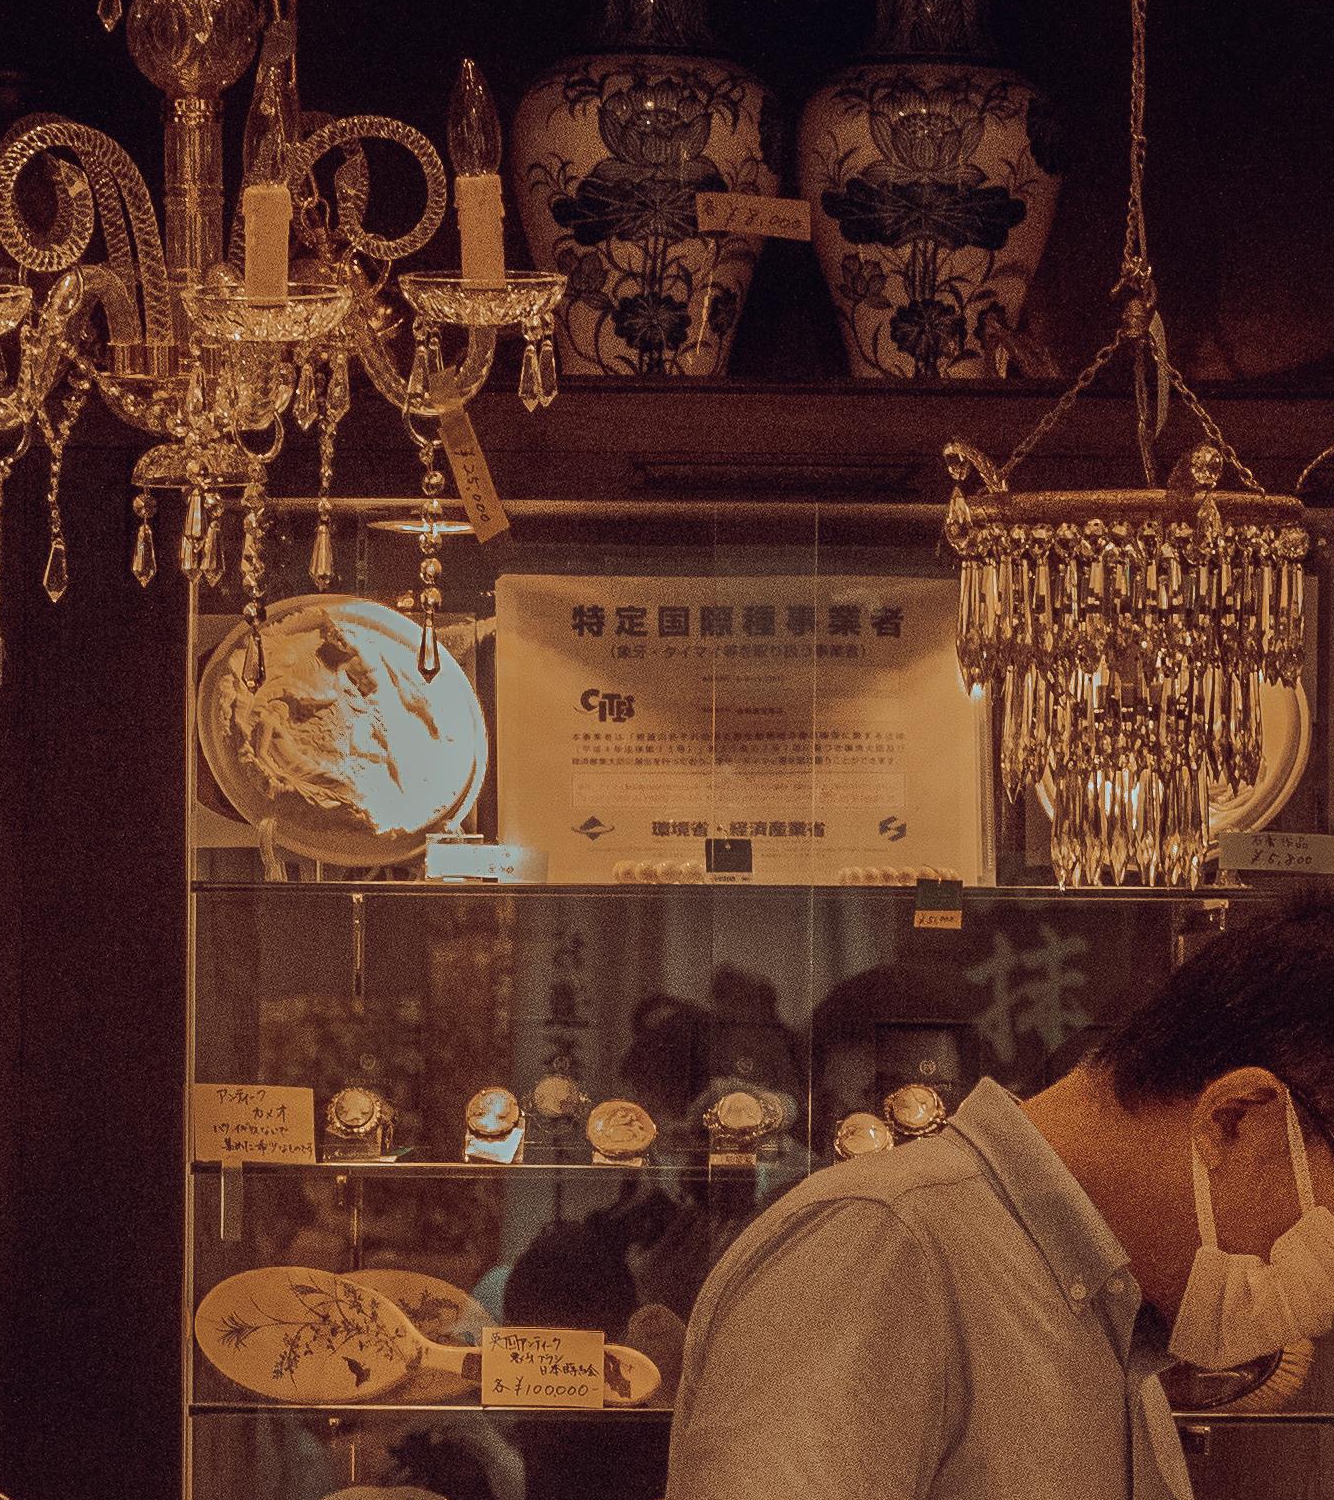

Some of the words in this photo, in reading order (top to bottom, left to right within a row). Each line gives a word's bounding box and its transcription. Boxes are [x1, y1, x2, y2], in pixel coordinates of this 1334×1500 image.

[571, 604, 904, 639] 特定国際種事業者
